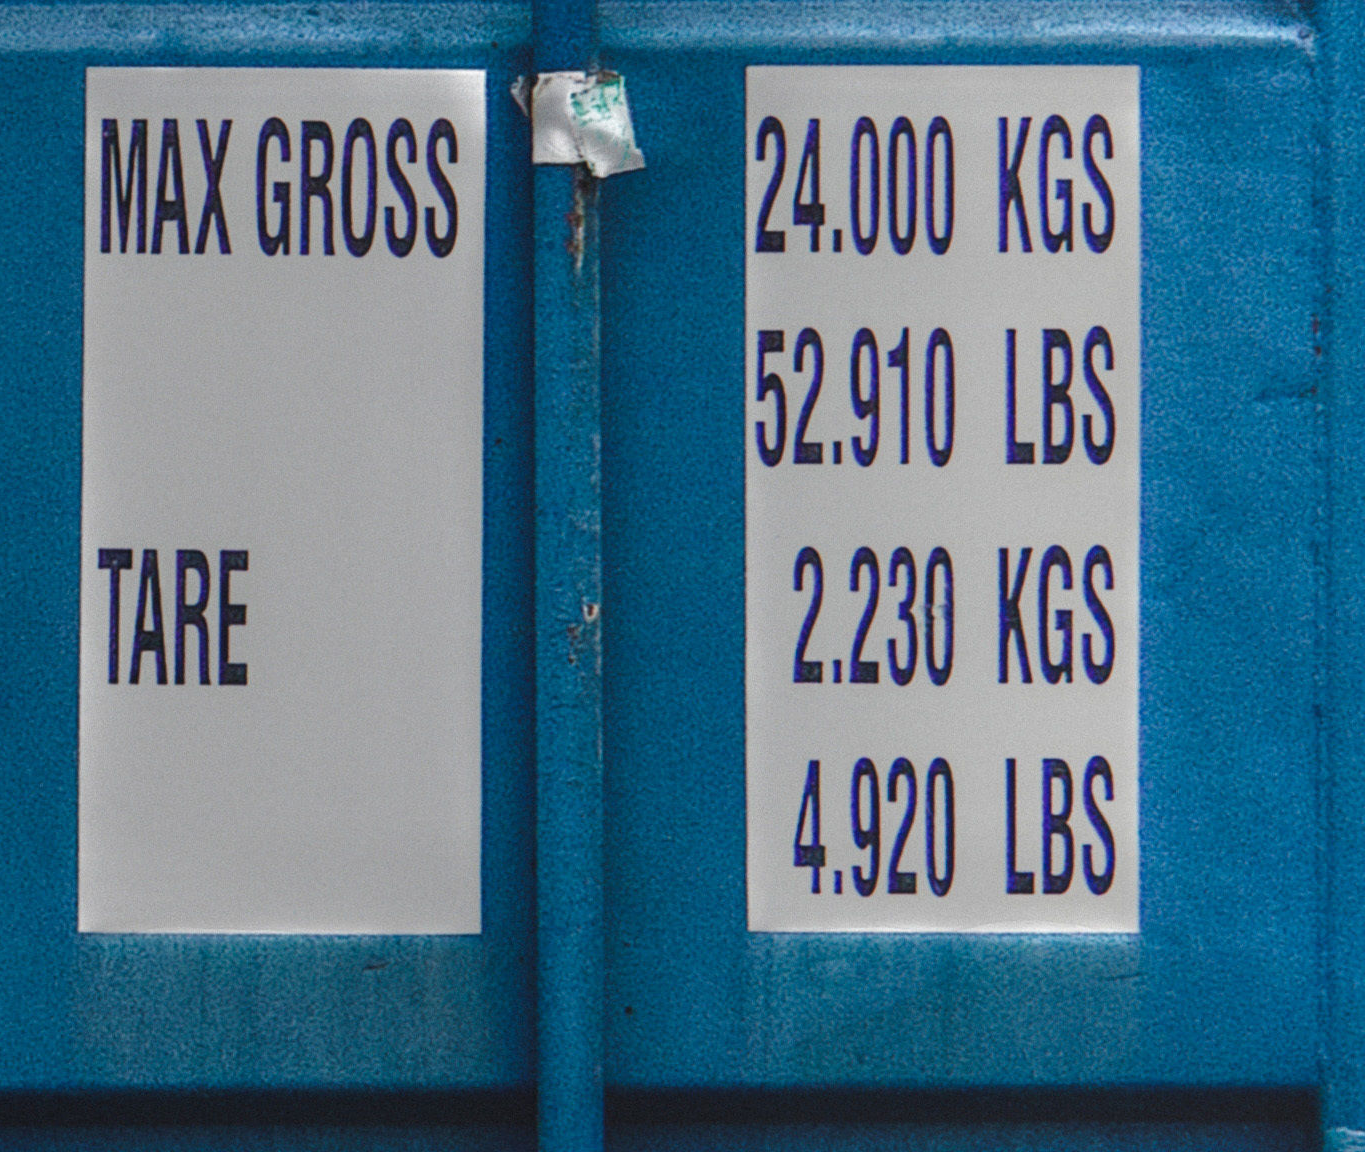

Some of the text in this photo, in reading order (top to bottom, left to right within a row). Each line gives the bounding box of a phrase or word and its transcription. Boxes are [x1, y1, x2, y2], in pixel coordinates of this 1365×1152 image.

[97, 117, 460, 258] MAX GROSS
[754, 115, 1116, 254] 24.000 KGS
[754, 327, 1116, 466] 52.910 LBS
[97, 549, 249, 686] TARE
[792, 546, 1116, 684] 2.230 KGS
[792, 757, 1116, 896] 4.920 LBS
